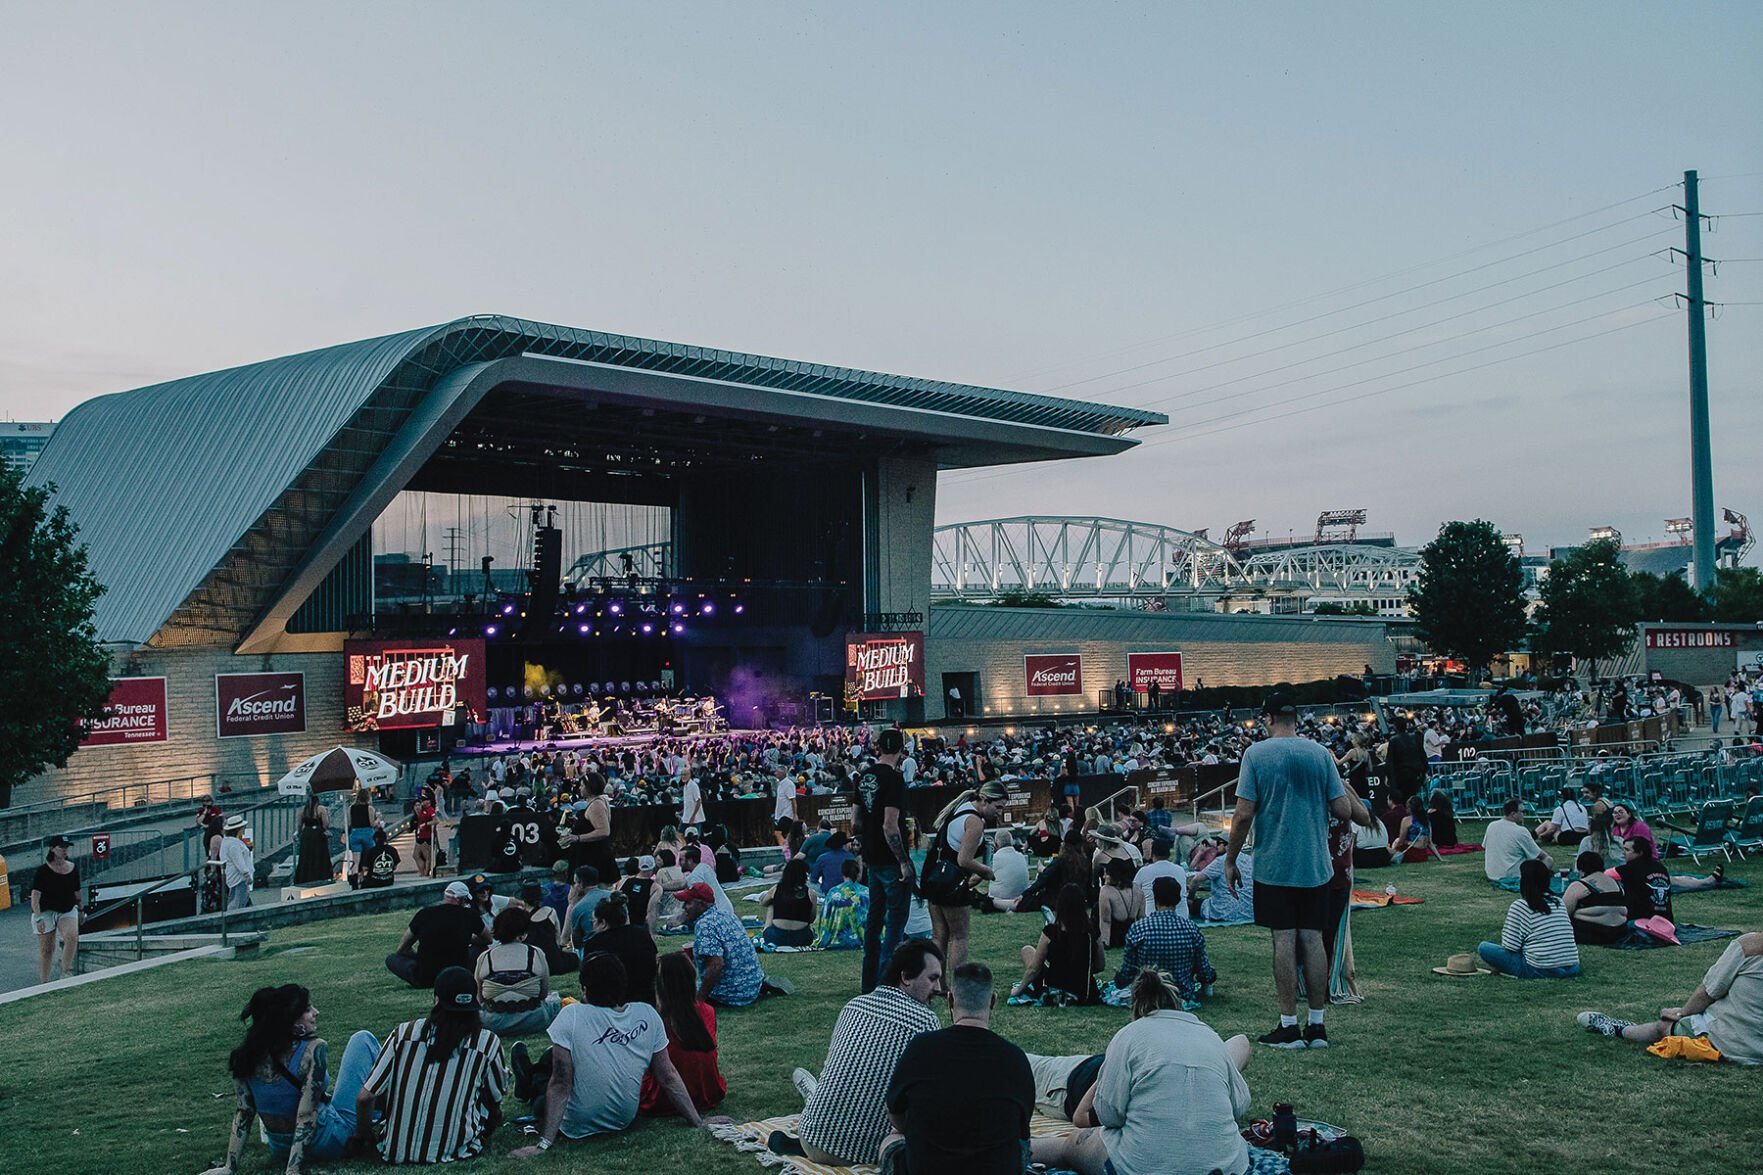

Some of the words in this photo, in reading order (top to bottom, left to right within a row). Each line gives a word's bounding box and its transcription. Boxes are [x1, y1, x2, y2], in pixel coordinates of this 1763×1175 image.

[1656, 632, 1731, 647] RESTROOMS
[856, 643, 915, 671] MEDIUM
[363, 654, 469, 691] MEDIUM
[863, 666, 909, 692] BUILD
[1031, 669, 1076, 682] Ascend
[1135, 668, 1153, 676] Farm
[1154, 667, 1177, 676] Bureau
[115, 703, 156, 715] Bureau
[226, 695, 297, 715] Ascend
[377, 684, 456, 719] BUILD
[226, 715, 252, 723] Federal
